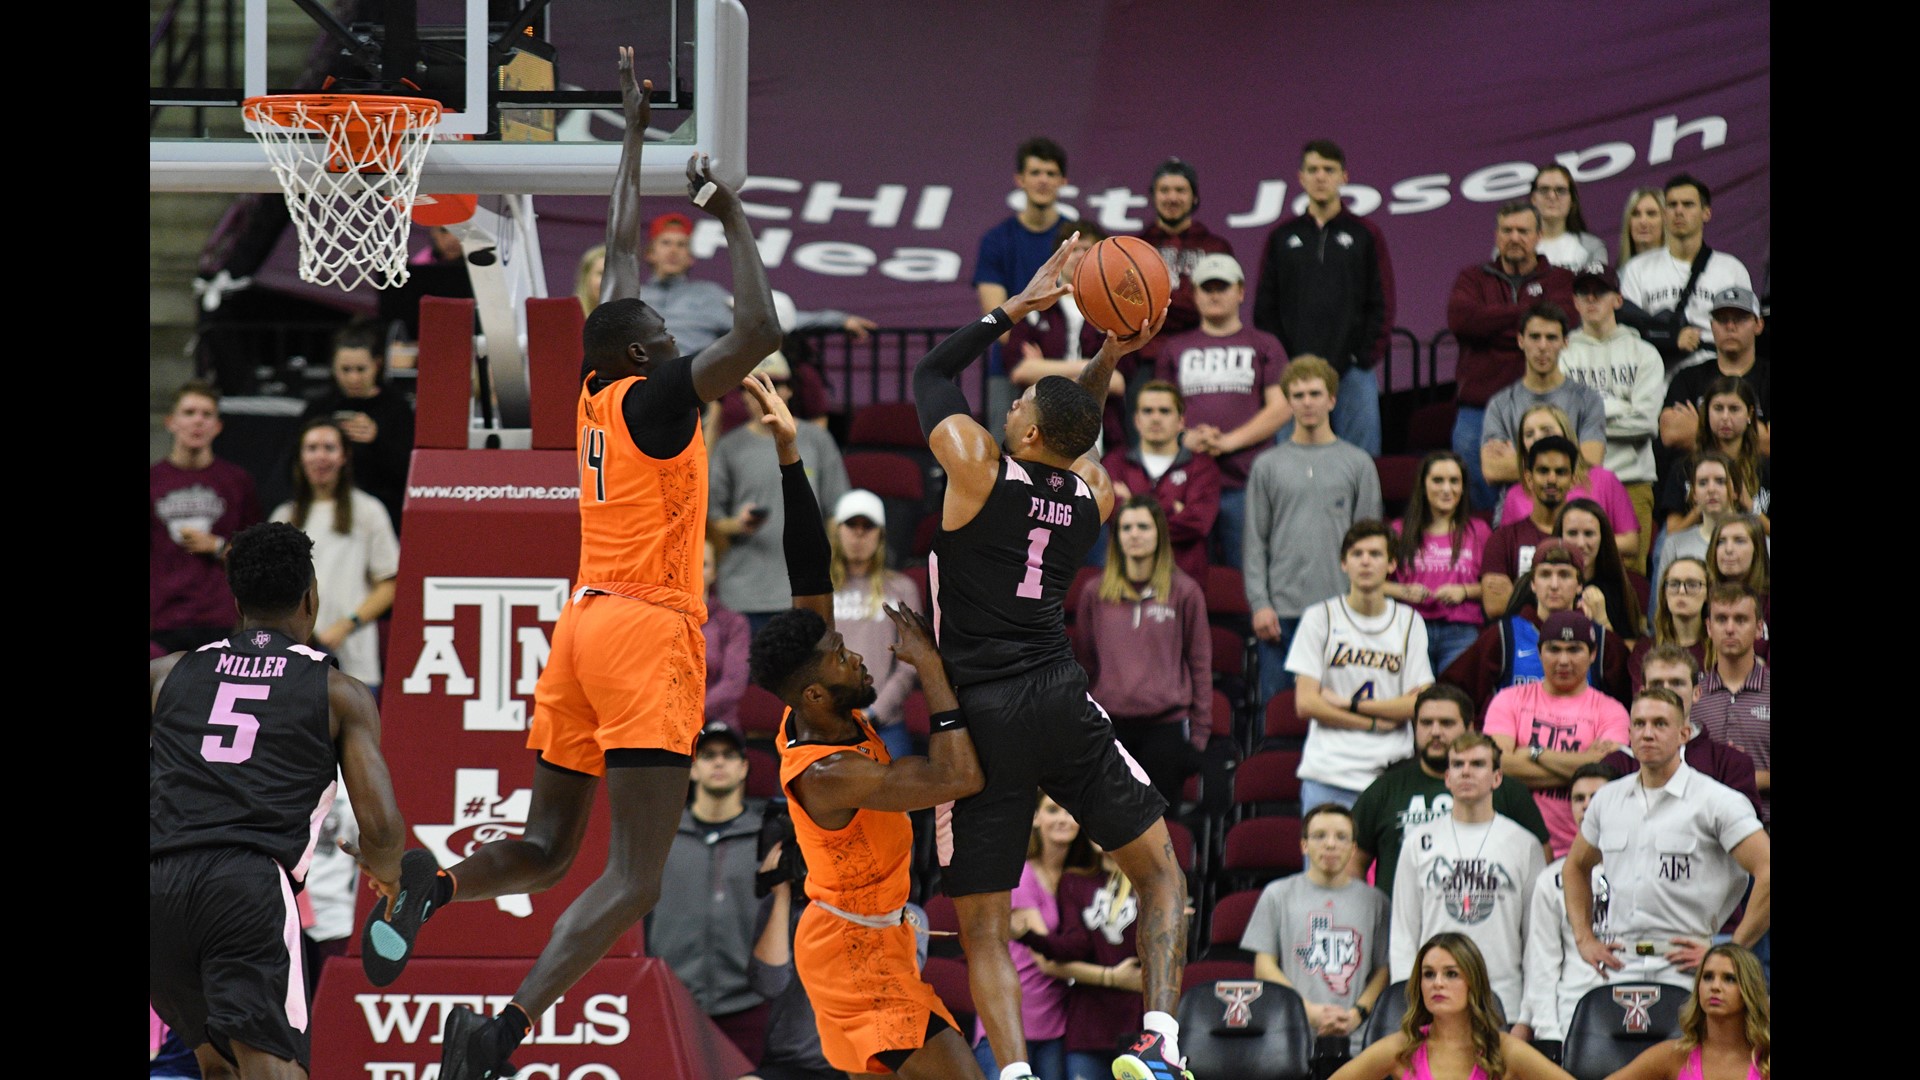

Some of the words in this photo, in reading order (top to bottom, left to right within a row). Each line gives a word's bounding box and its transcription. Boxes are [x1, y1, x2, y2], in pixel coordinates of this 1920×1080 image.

[1226, 114, 1728, 229] Joseph
[1179, 346, 1257, 373] GRIT
[1027, 496, 1073, 527] FLAGG
[1016, 527, 1052, 600] 1
[214, 653, 288, 679] MILLER
[1328, 641, 1402, 675] LAKERS
[200, 681, 271, 764] 5
[1421, 834, 1433, 851] C
